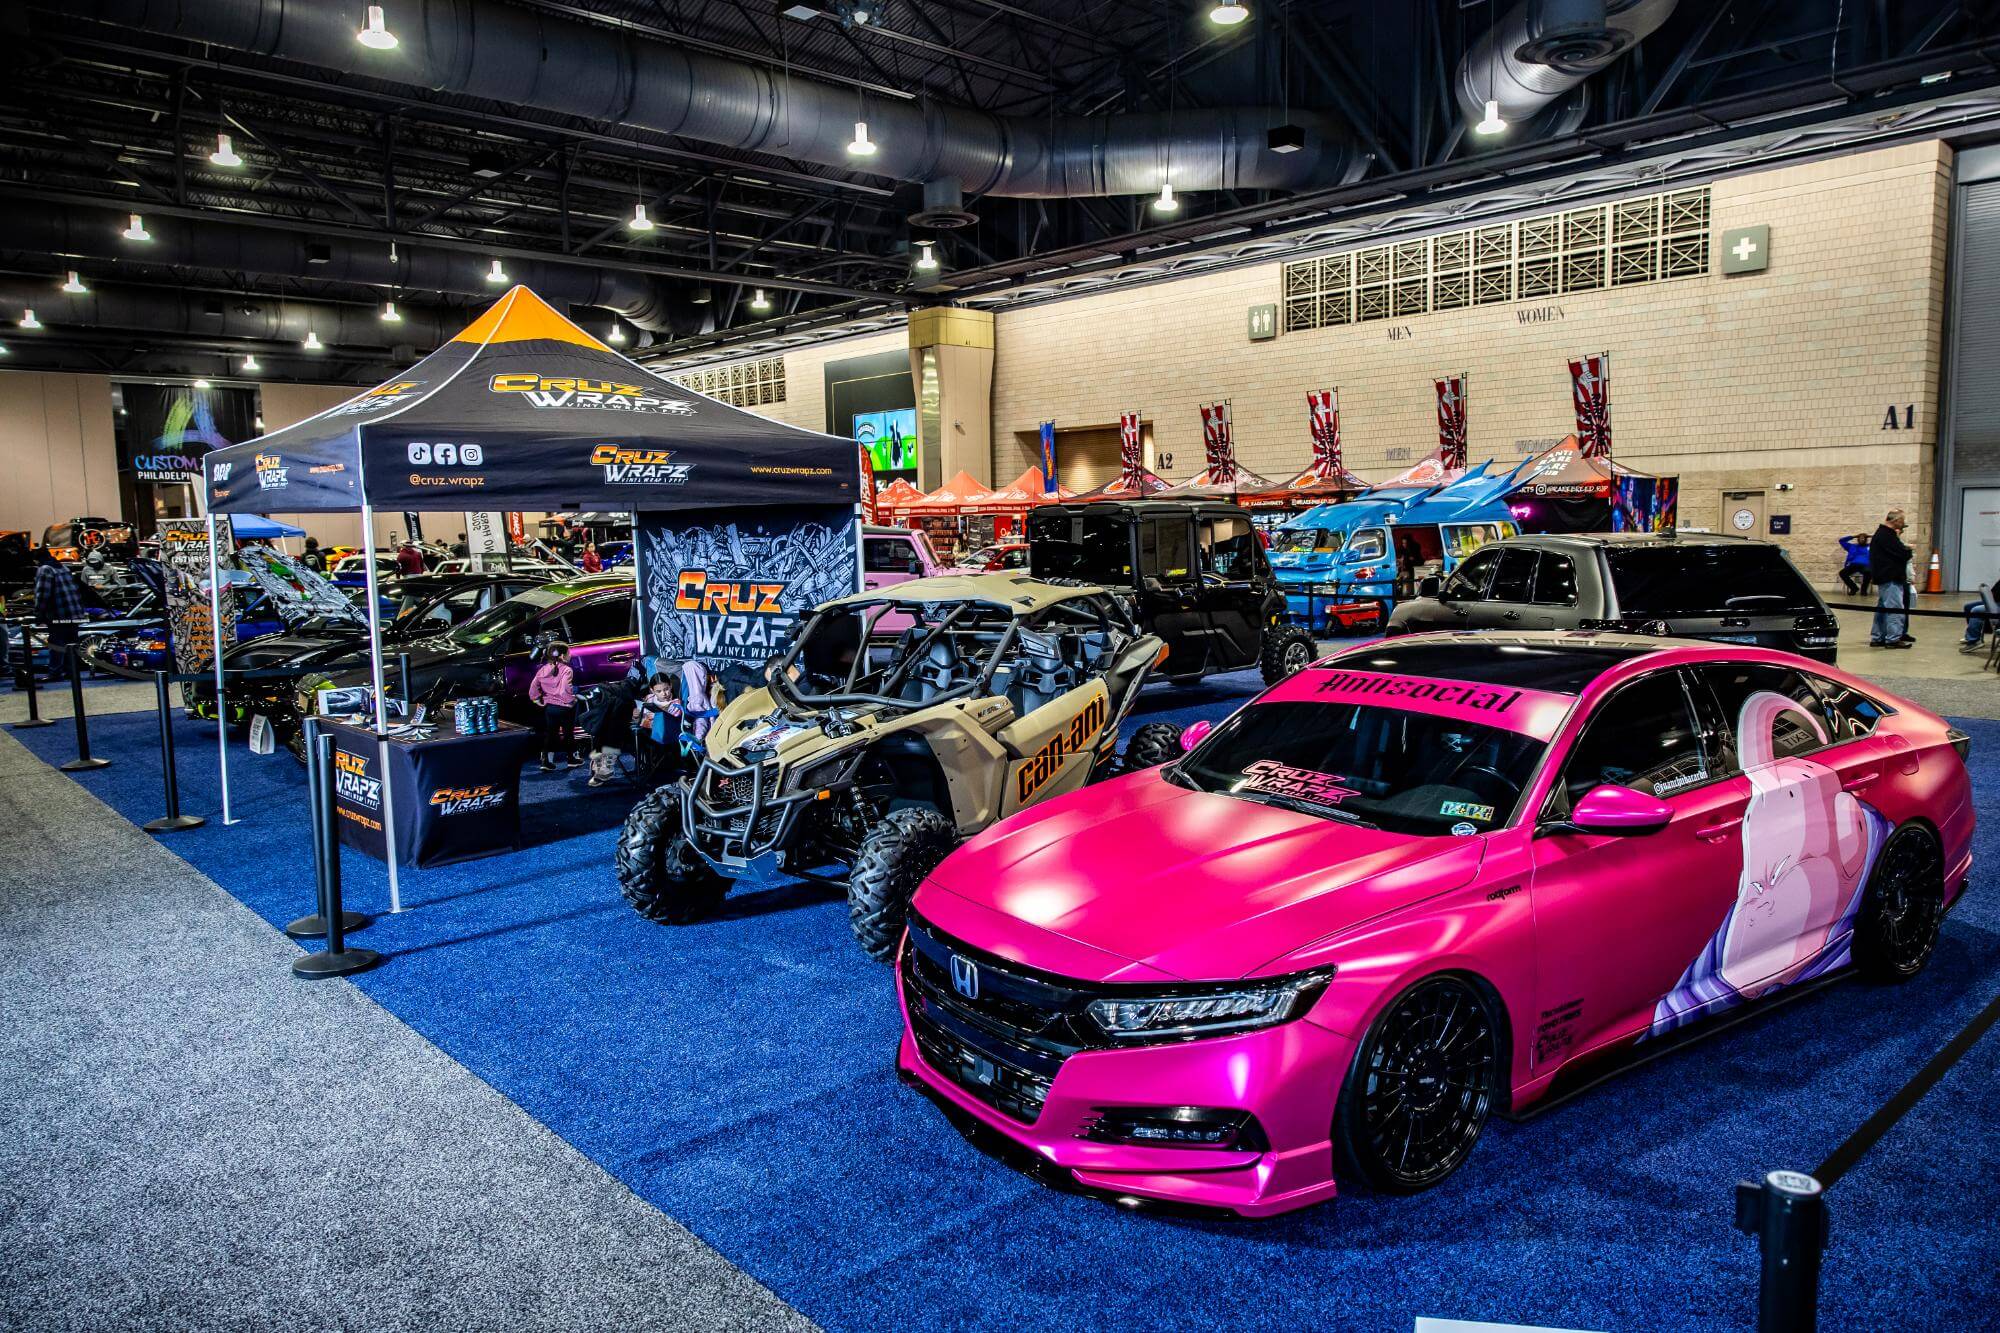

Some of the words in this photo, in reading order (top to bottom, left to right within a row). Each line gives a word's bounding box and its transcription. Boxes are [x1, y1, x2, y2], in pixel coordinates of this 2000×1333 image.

[1517, 306, 1565, 325] WOMEN
[1387, 326, 1412, 341] MEN
[493, 374, 644, 396] CRUZ
[524, 391, 693, 411] WRAPZ
[1881, 404, 1915, 429] A1
[134, 454, 198, 471] CUSTOM
[591, 445, 670, 464] CRUZ
[1157, 453, 1173, 470] A2
[409, 473, 485, 488] @cruz.wrapz
[605, 464, 691, 482] WRAPZ
[750, 466, 833, 477] www.cruzwrapz.com
[675, 571, 785, 615] CRUZ
[694, 615, 794, 653] WRAP
[717, 646, 746, 656] VINYL
[1017, 694, 1105, 804] can-am
[335, 751, 366, 777] RUZ
[1244, 761, 1336, 785] CRUZ
[430, 785, 493, 804] CRUZ
[1244, 774, 1352, 801] WRAPZ
[441, 791, 506, 816] WRAPZ
